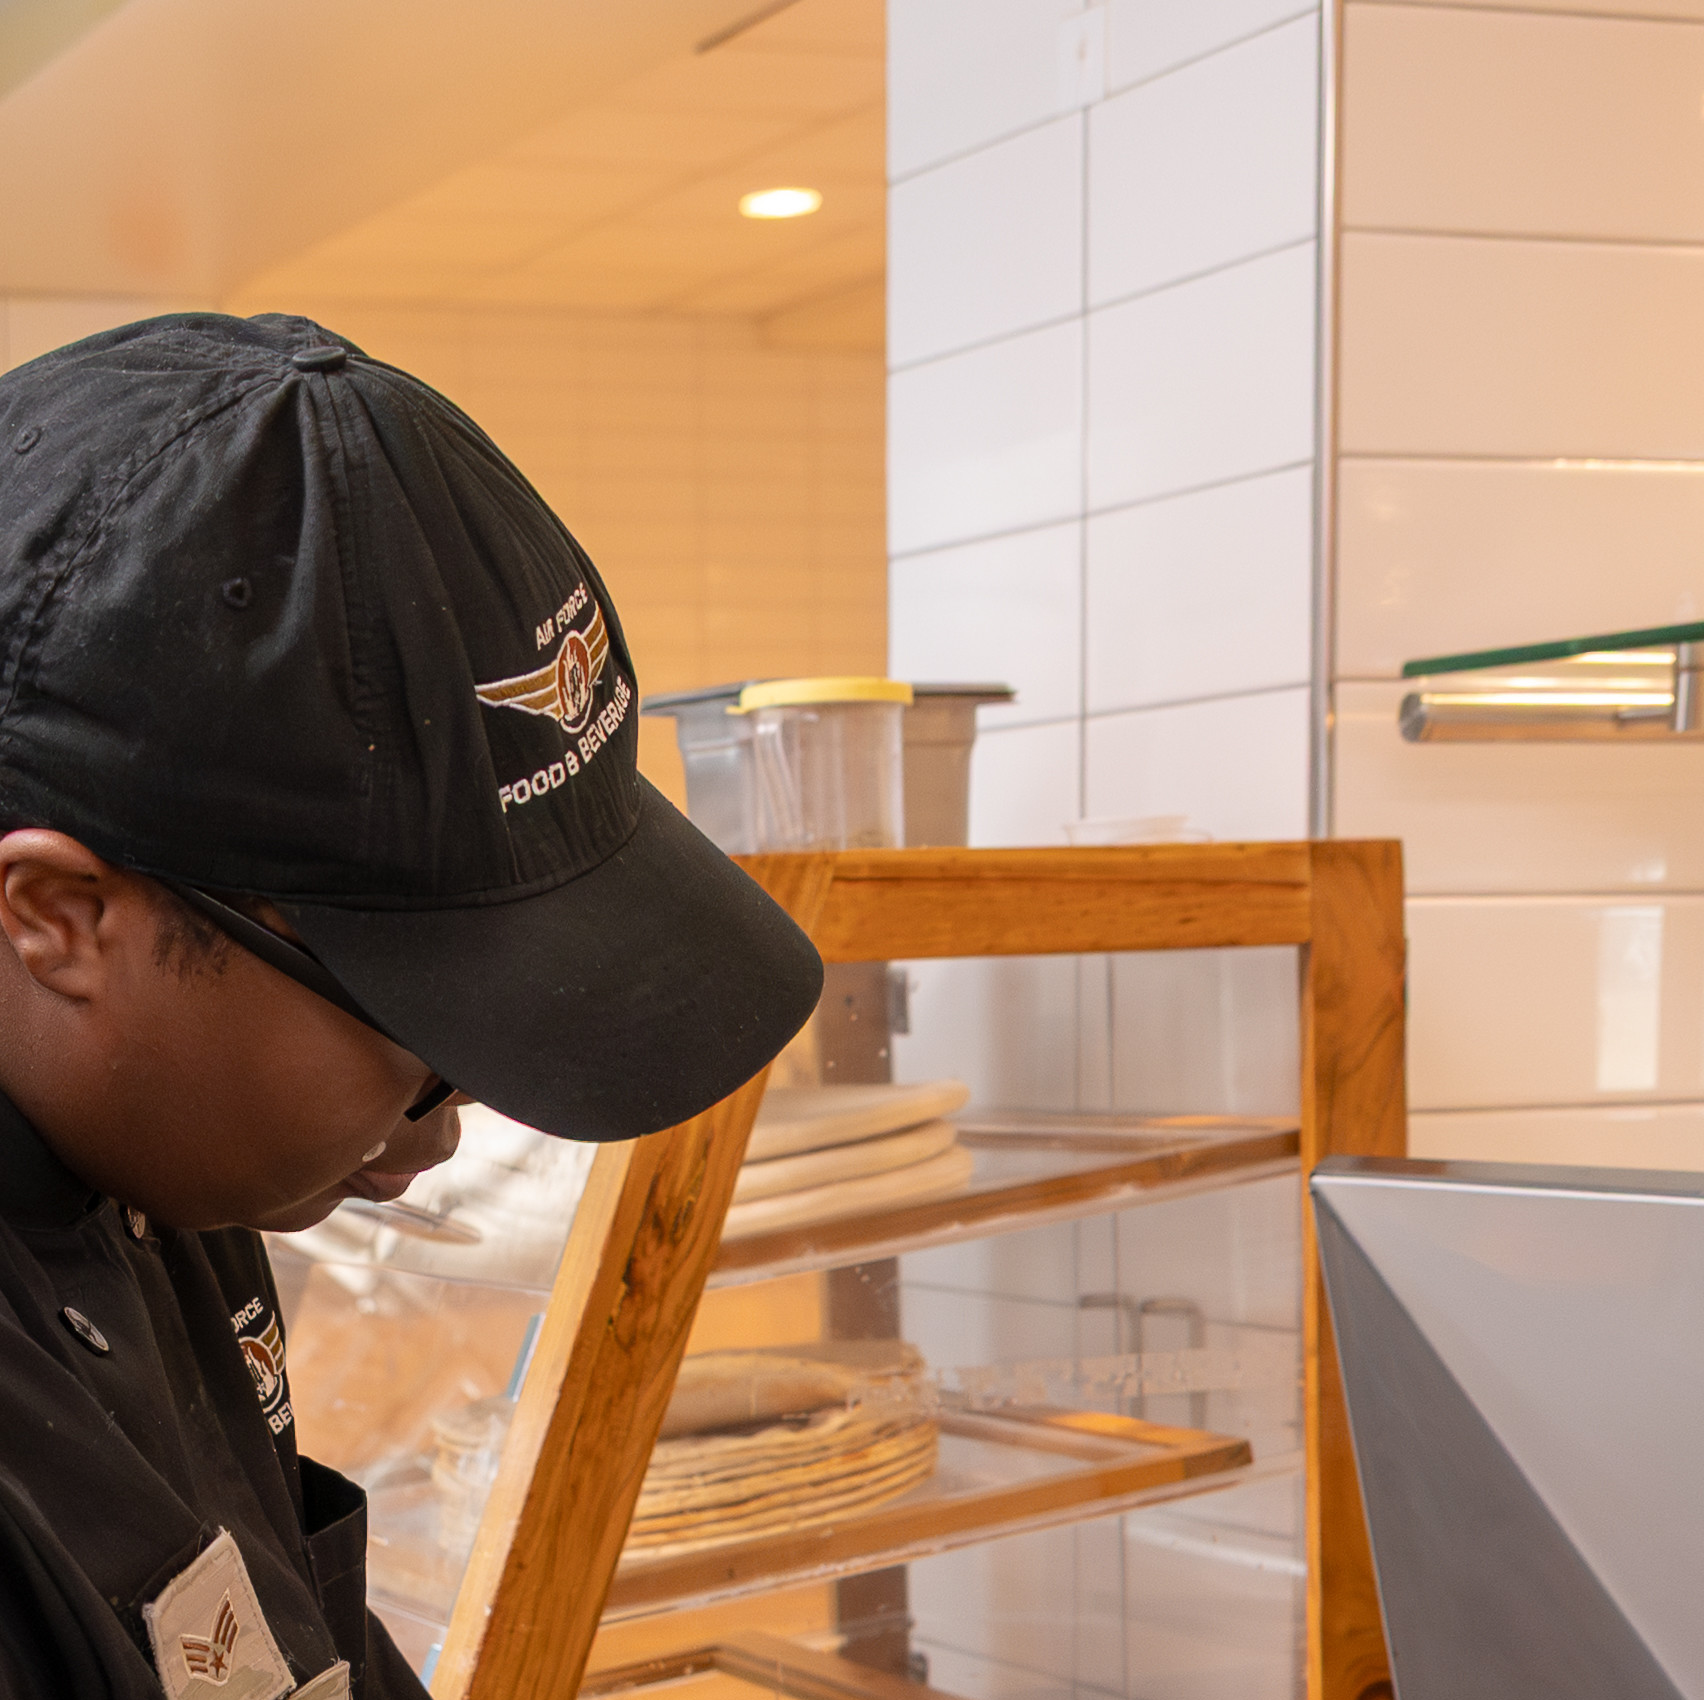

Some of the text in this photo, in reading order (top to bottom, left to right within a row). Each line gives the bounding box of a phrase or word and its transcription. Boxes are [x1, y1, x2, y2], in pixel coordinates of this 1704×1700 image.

[535, 581, 589, 651] AIR FORCE
[498, 760, 567, 814] FOOD
[577, 674, 632, 765] BEVERAGE
